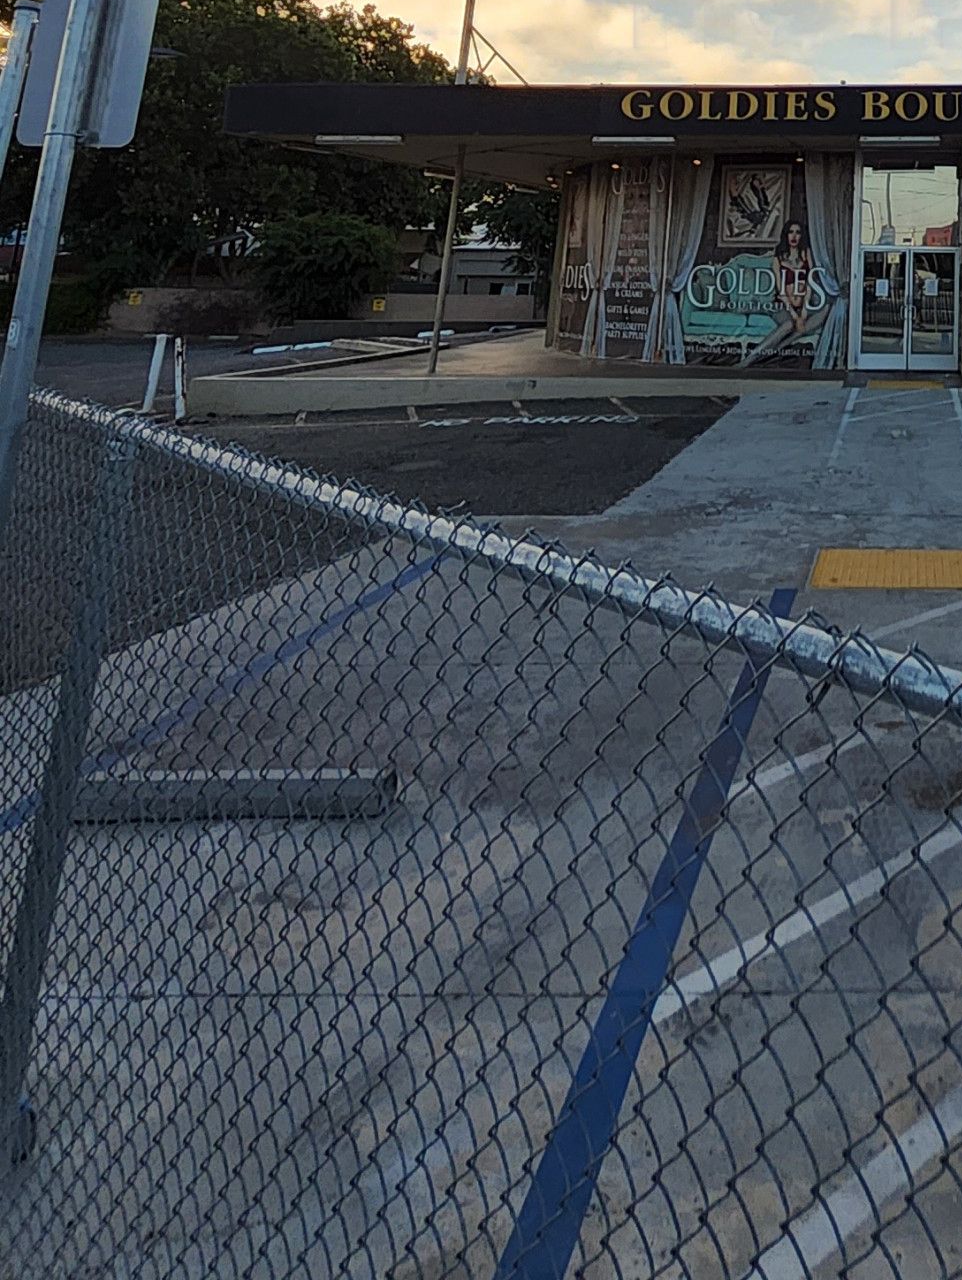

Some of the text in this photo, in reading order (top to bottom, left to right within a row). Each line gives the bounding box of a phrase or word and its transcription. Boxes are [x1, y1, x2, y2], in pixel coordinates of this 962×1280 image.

[620, 89, 837, 121] GOLDIES
[687, 264, 827, 311] GOLDIES
[606, 305, 622, 314] GIFTS
[629, 305, 649, 315] GAMES
[719, 301, 793, 312] BOUTIQUE
[418, 415, 640, 428] NO PARKING
